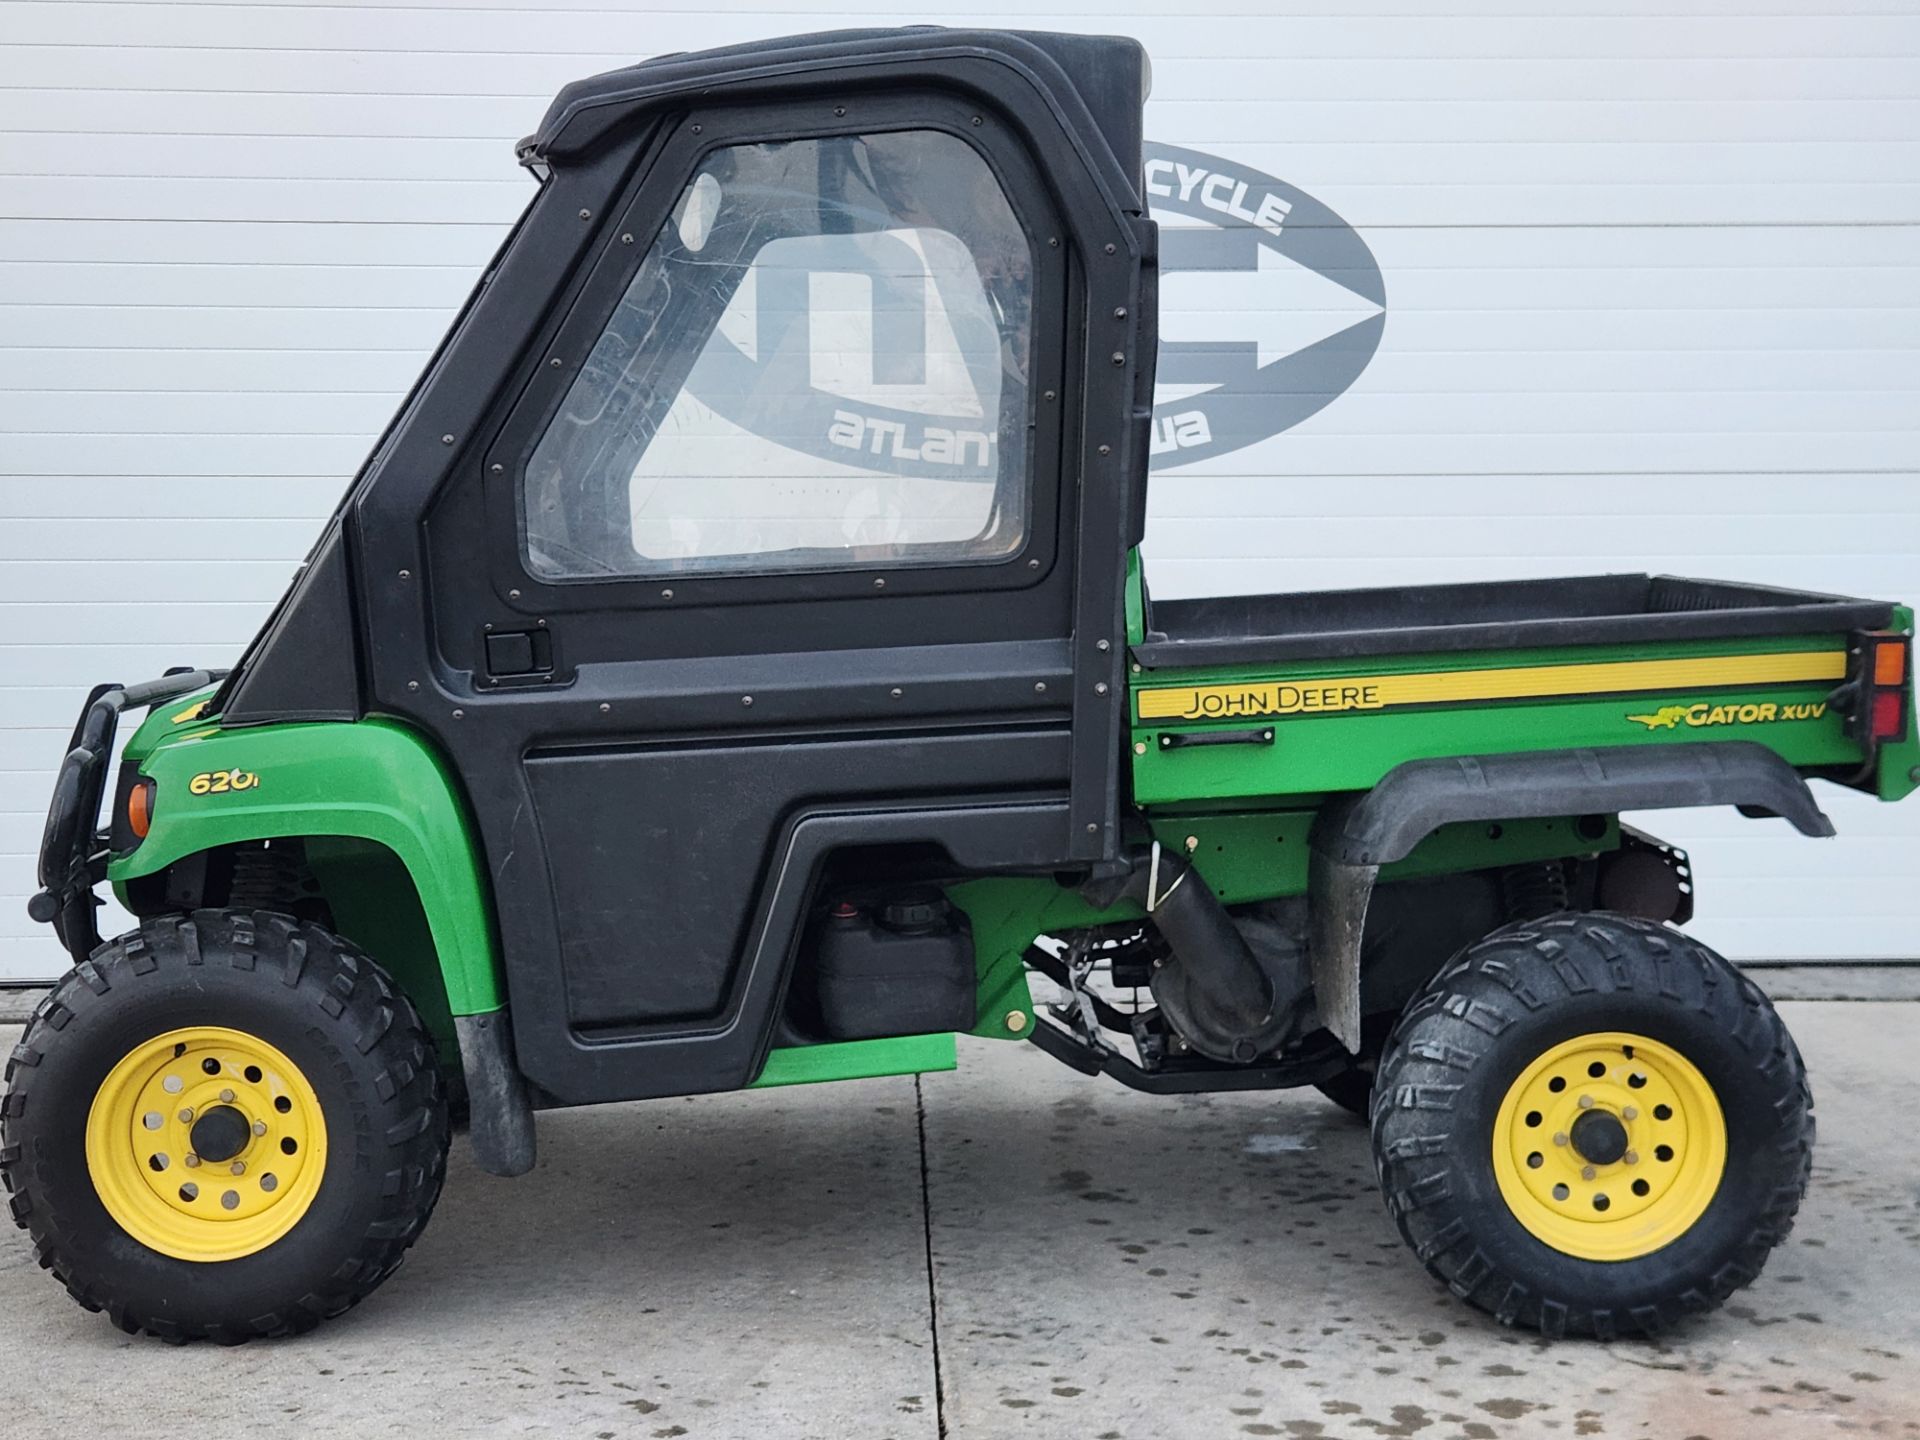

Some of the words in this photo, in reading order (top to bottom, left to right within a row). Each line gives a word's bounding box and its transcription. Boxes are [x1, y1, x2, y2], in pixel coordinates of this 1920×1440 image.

[1144, 158, 1293, 237] CYCLE
[1183, 691, 1268, 714] JOHN
[1277, 685, 1379, 709] DEERE
[1684, 702, 1778, 726] GATOR
[1780, 702, 1827, 721] XUV
